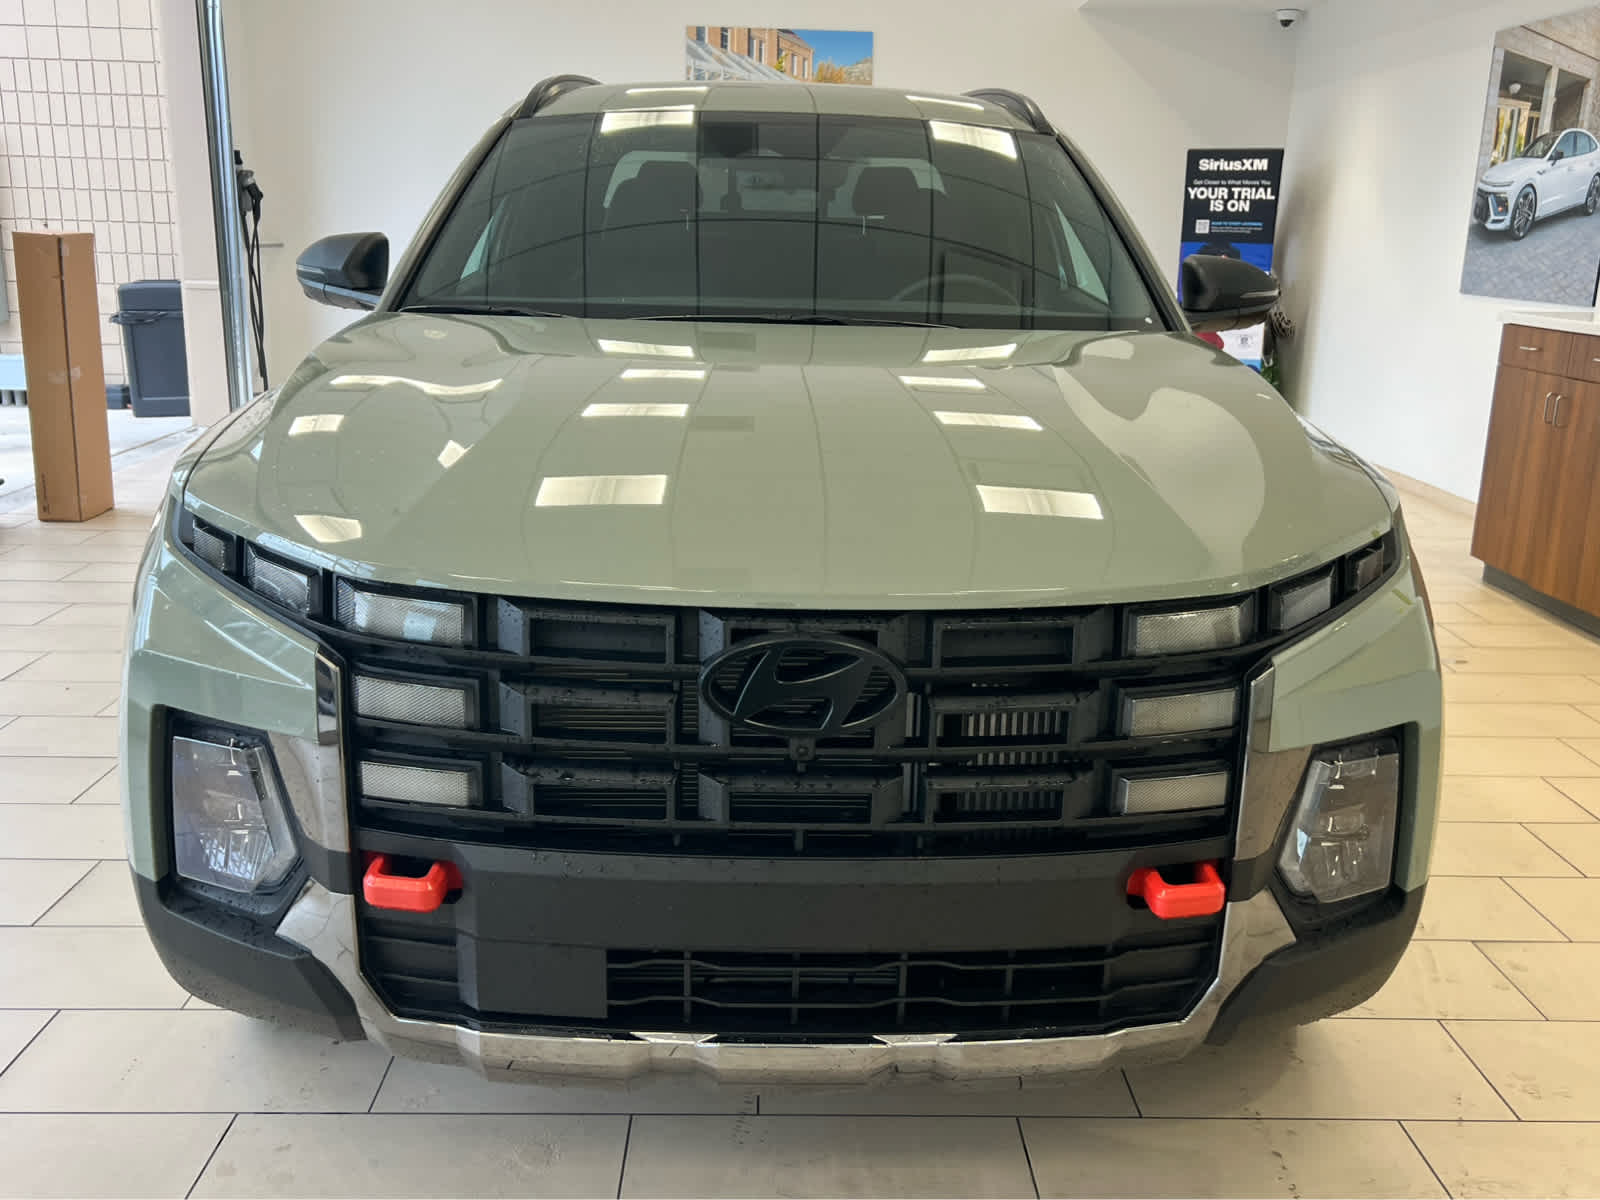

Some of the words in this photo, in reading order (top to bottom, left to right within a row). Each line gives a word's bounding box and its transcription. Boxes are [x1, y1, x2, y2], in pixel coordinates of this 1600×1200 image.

[1198, 158, 1268, 170] SiriusXM
[1188, 187, 1228, 200] YOUR
[1232, 187, 1276, 200] TRIAL
[1210, 200, 1224, 212] IS
[1227, 200, 1250, 212] ON
